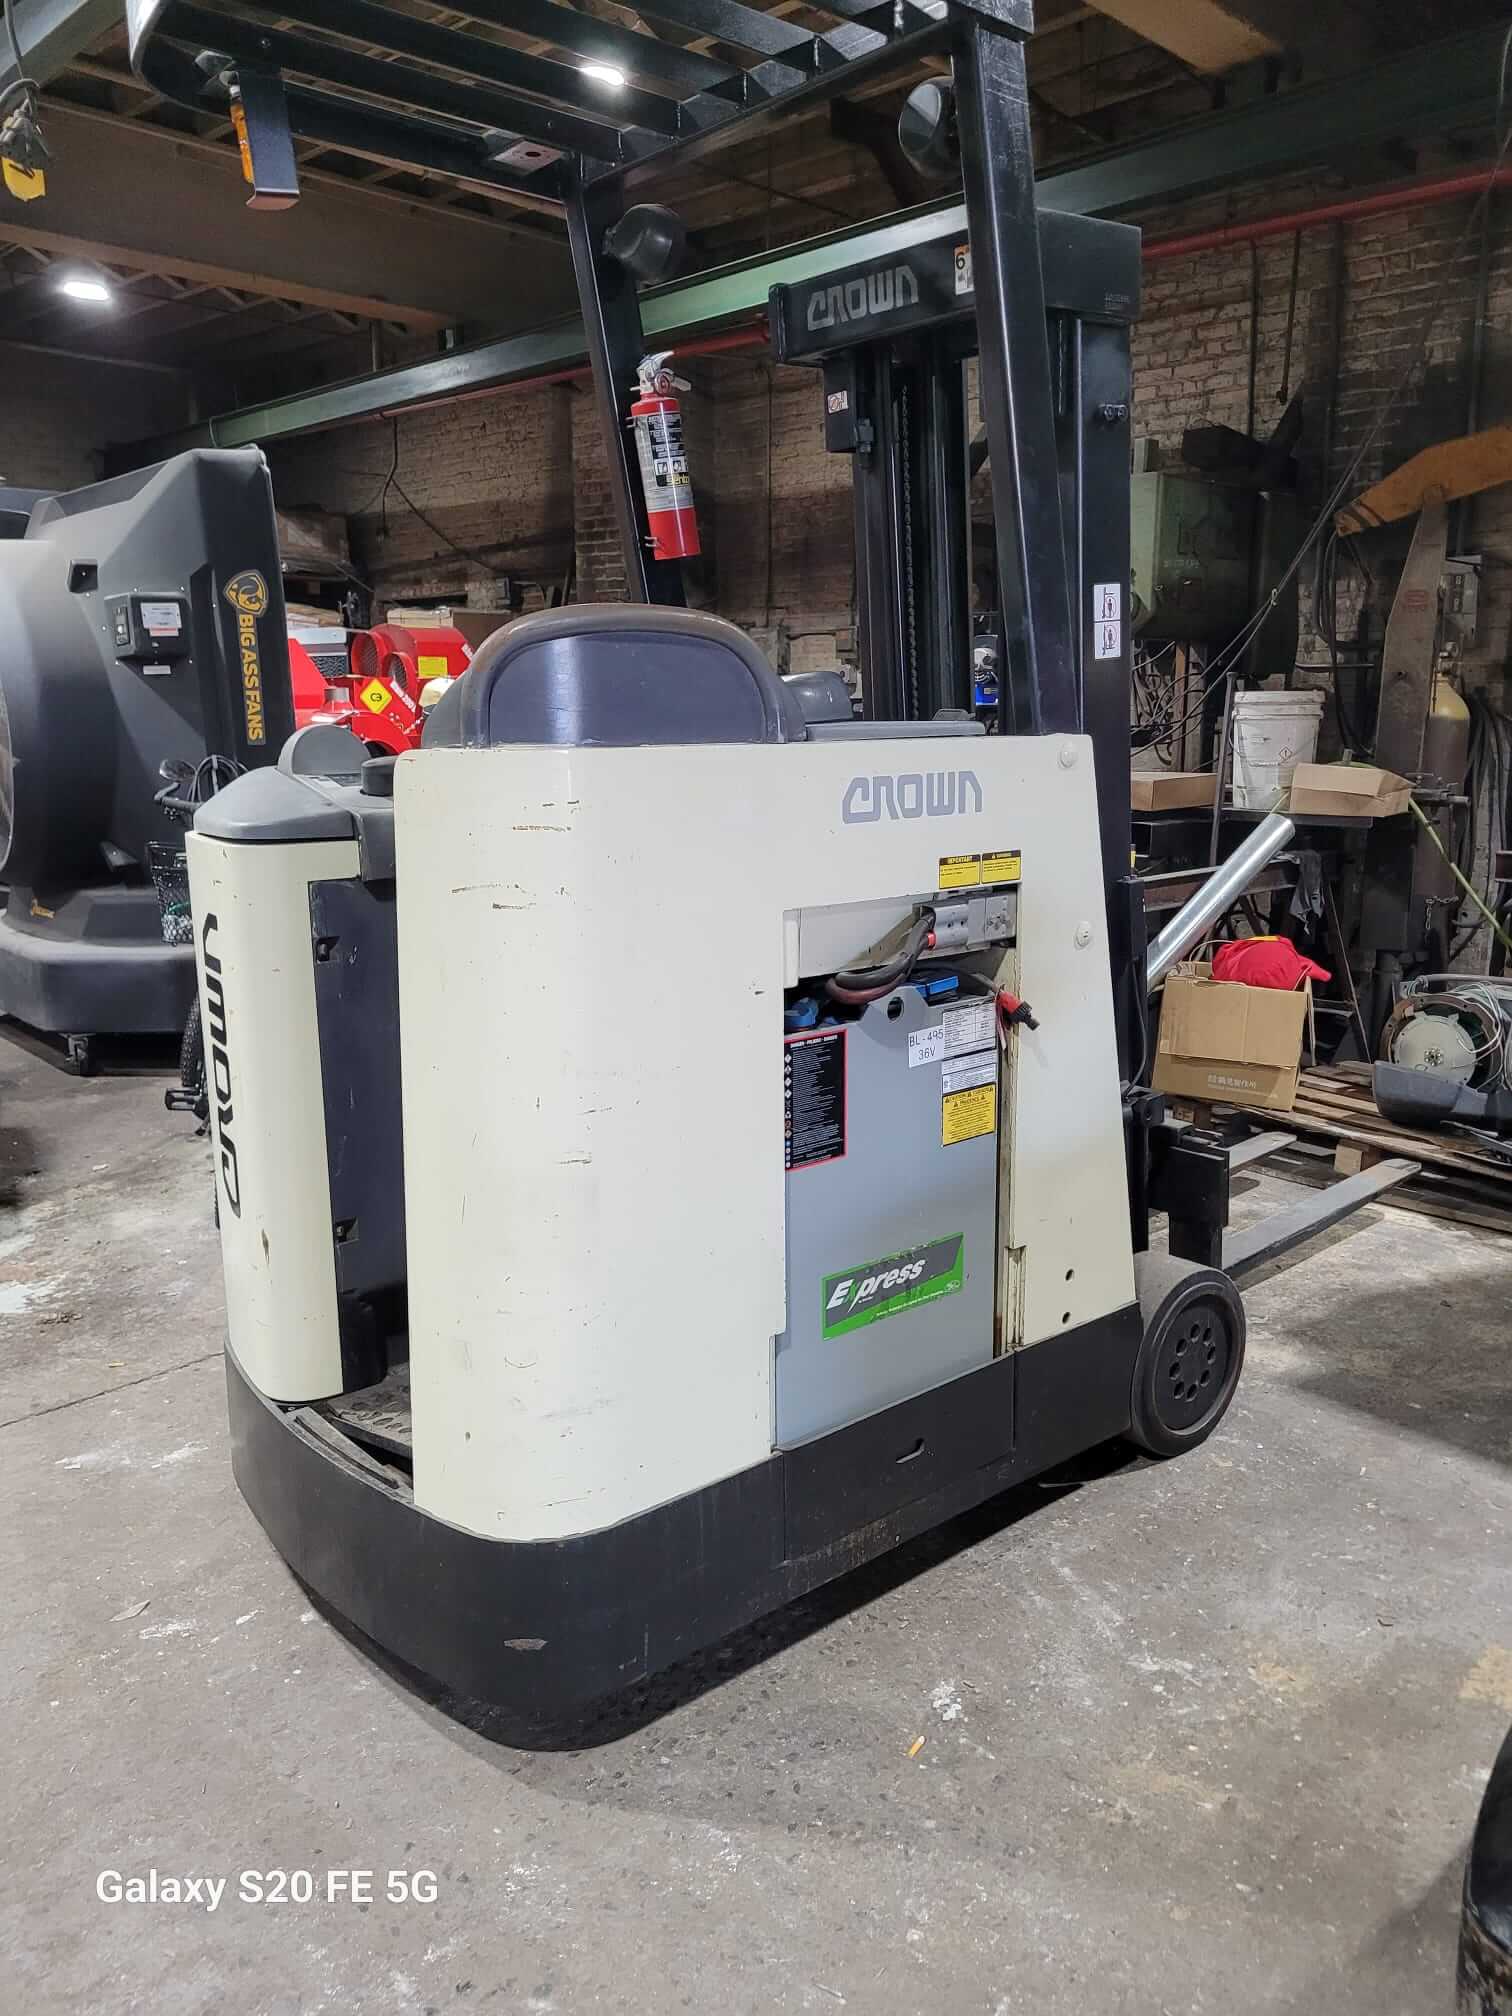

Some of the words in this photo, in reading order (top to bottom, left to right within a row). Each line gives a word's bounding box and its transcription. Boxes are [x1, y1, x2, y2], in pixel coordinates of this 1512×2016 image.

[807, 265, 919, 331] CROWN
[239, 613, 256, 651] BIG
[241, 650, 260, 689] ASS
[244, 690, 264, 741] FANS
[842, 770, 983, 825] CROWN
[203, 912, 241, 1218] CROWN
[918, 1046, 936, 1061] 36V
